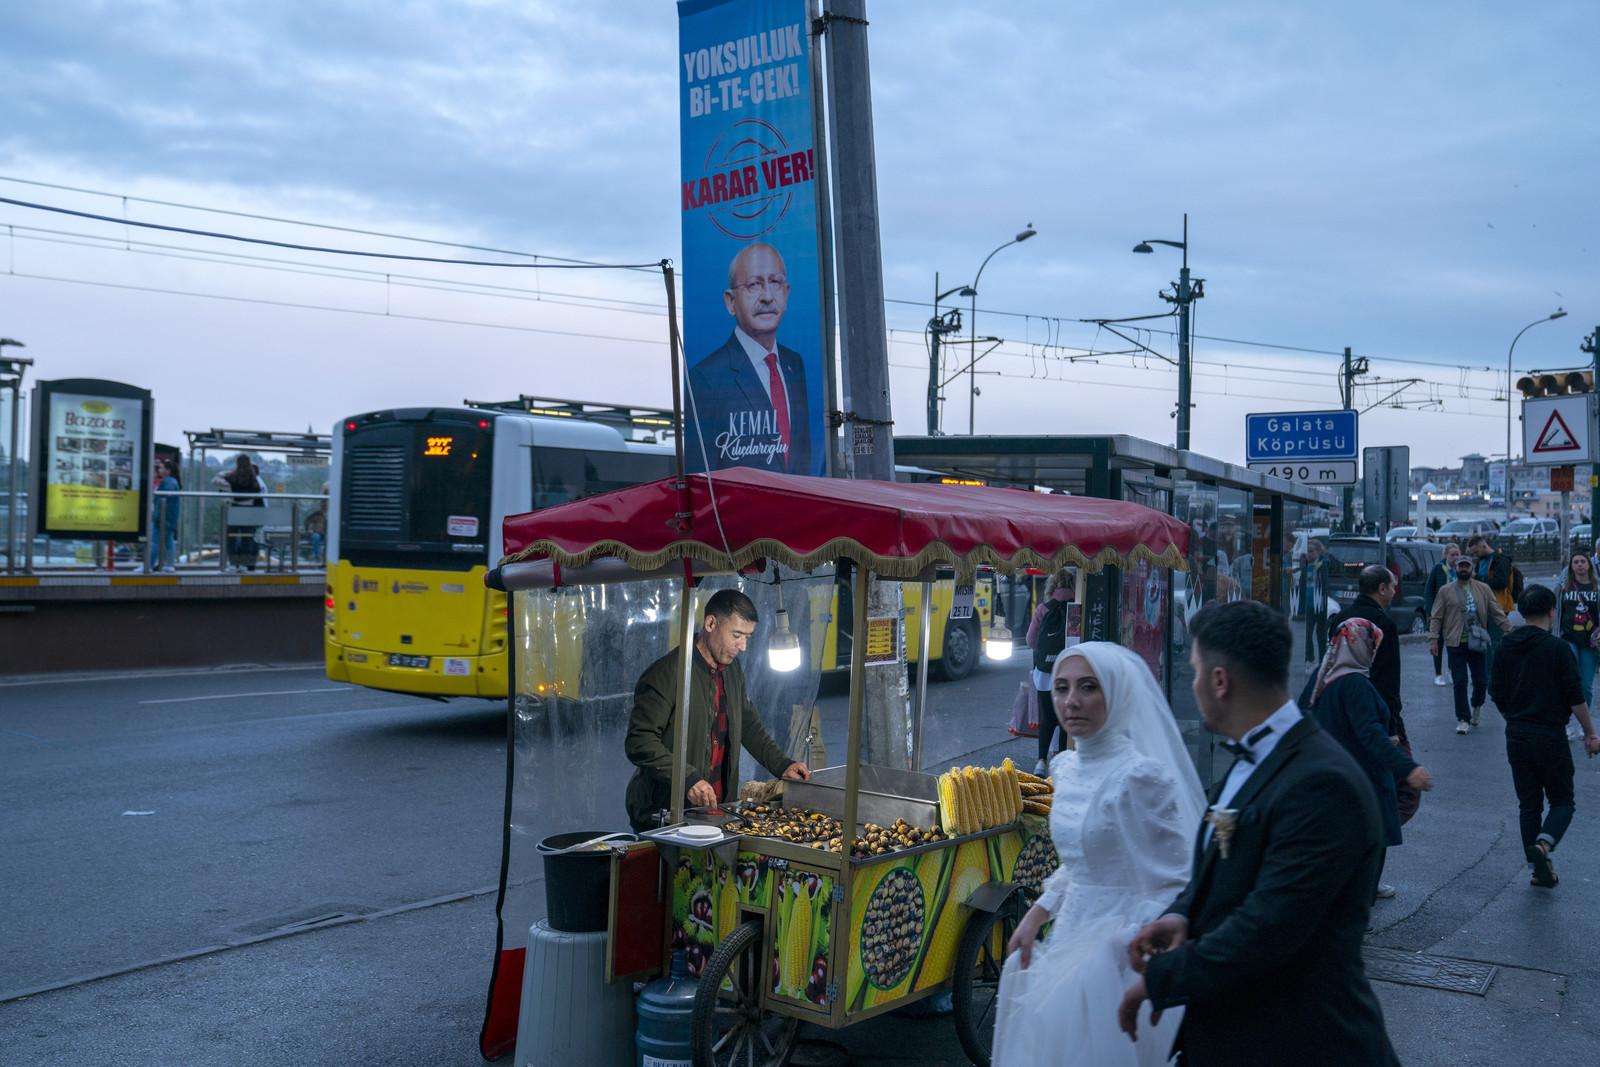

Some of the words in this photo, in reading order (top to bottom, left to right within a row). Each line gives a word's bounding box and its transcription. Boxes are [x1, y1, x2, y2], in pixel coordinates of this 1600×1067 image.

[684, 24, 802, 83] YOKSULLUK
[682, 164, 758, 211] KARAR
[761, 149, 815, 190] VER!
[729, 410, 780, 437] KEMAL
[1267, 418, 1334, 432] Galata
[1258, 436, 1345, 454] Köprüsü
[1268, 466, 1310, 480] 490
[1319, 470, 1337, 480] m
[953, 606, 961, 617] 25
[963, 605, 970, 617] TL
